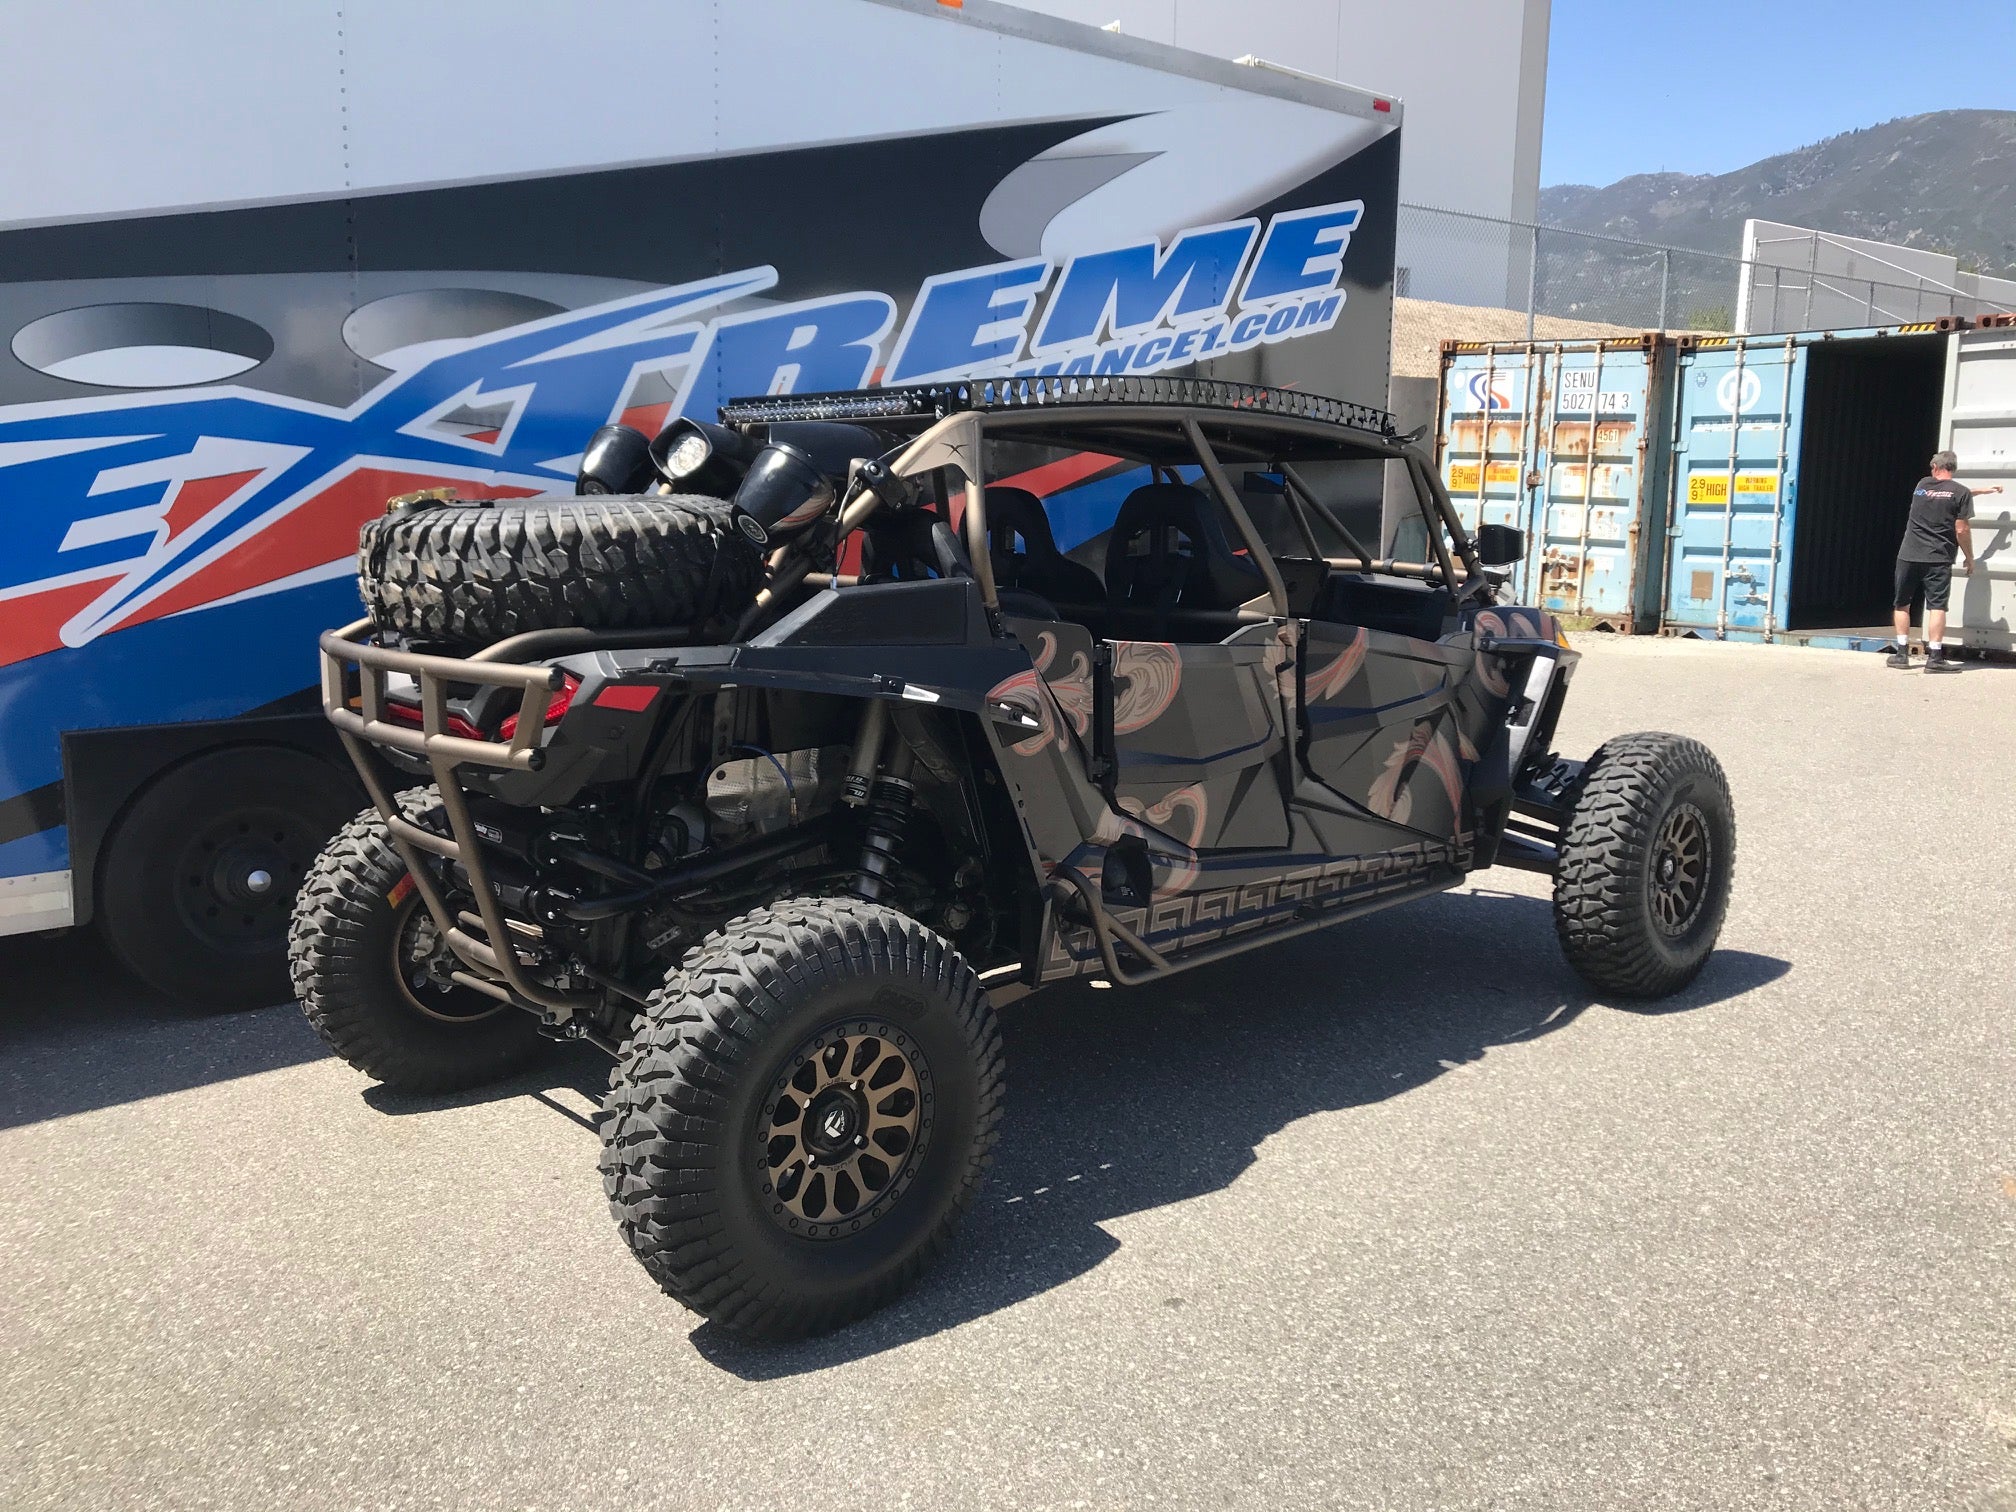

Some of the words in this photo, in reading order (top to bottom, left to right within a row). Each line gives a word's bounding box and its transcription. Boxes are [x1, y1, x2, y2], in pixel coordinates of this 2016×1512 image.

[1564, 371, 1595, 388] SENU
[1621, 393, 1629, 409] 3
[1463, 472, 1480, 485] HIGH
[1706, 483, 1727, 496] HIGH
